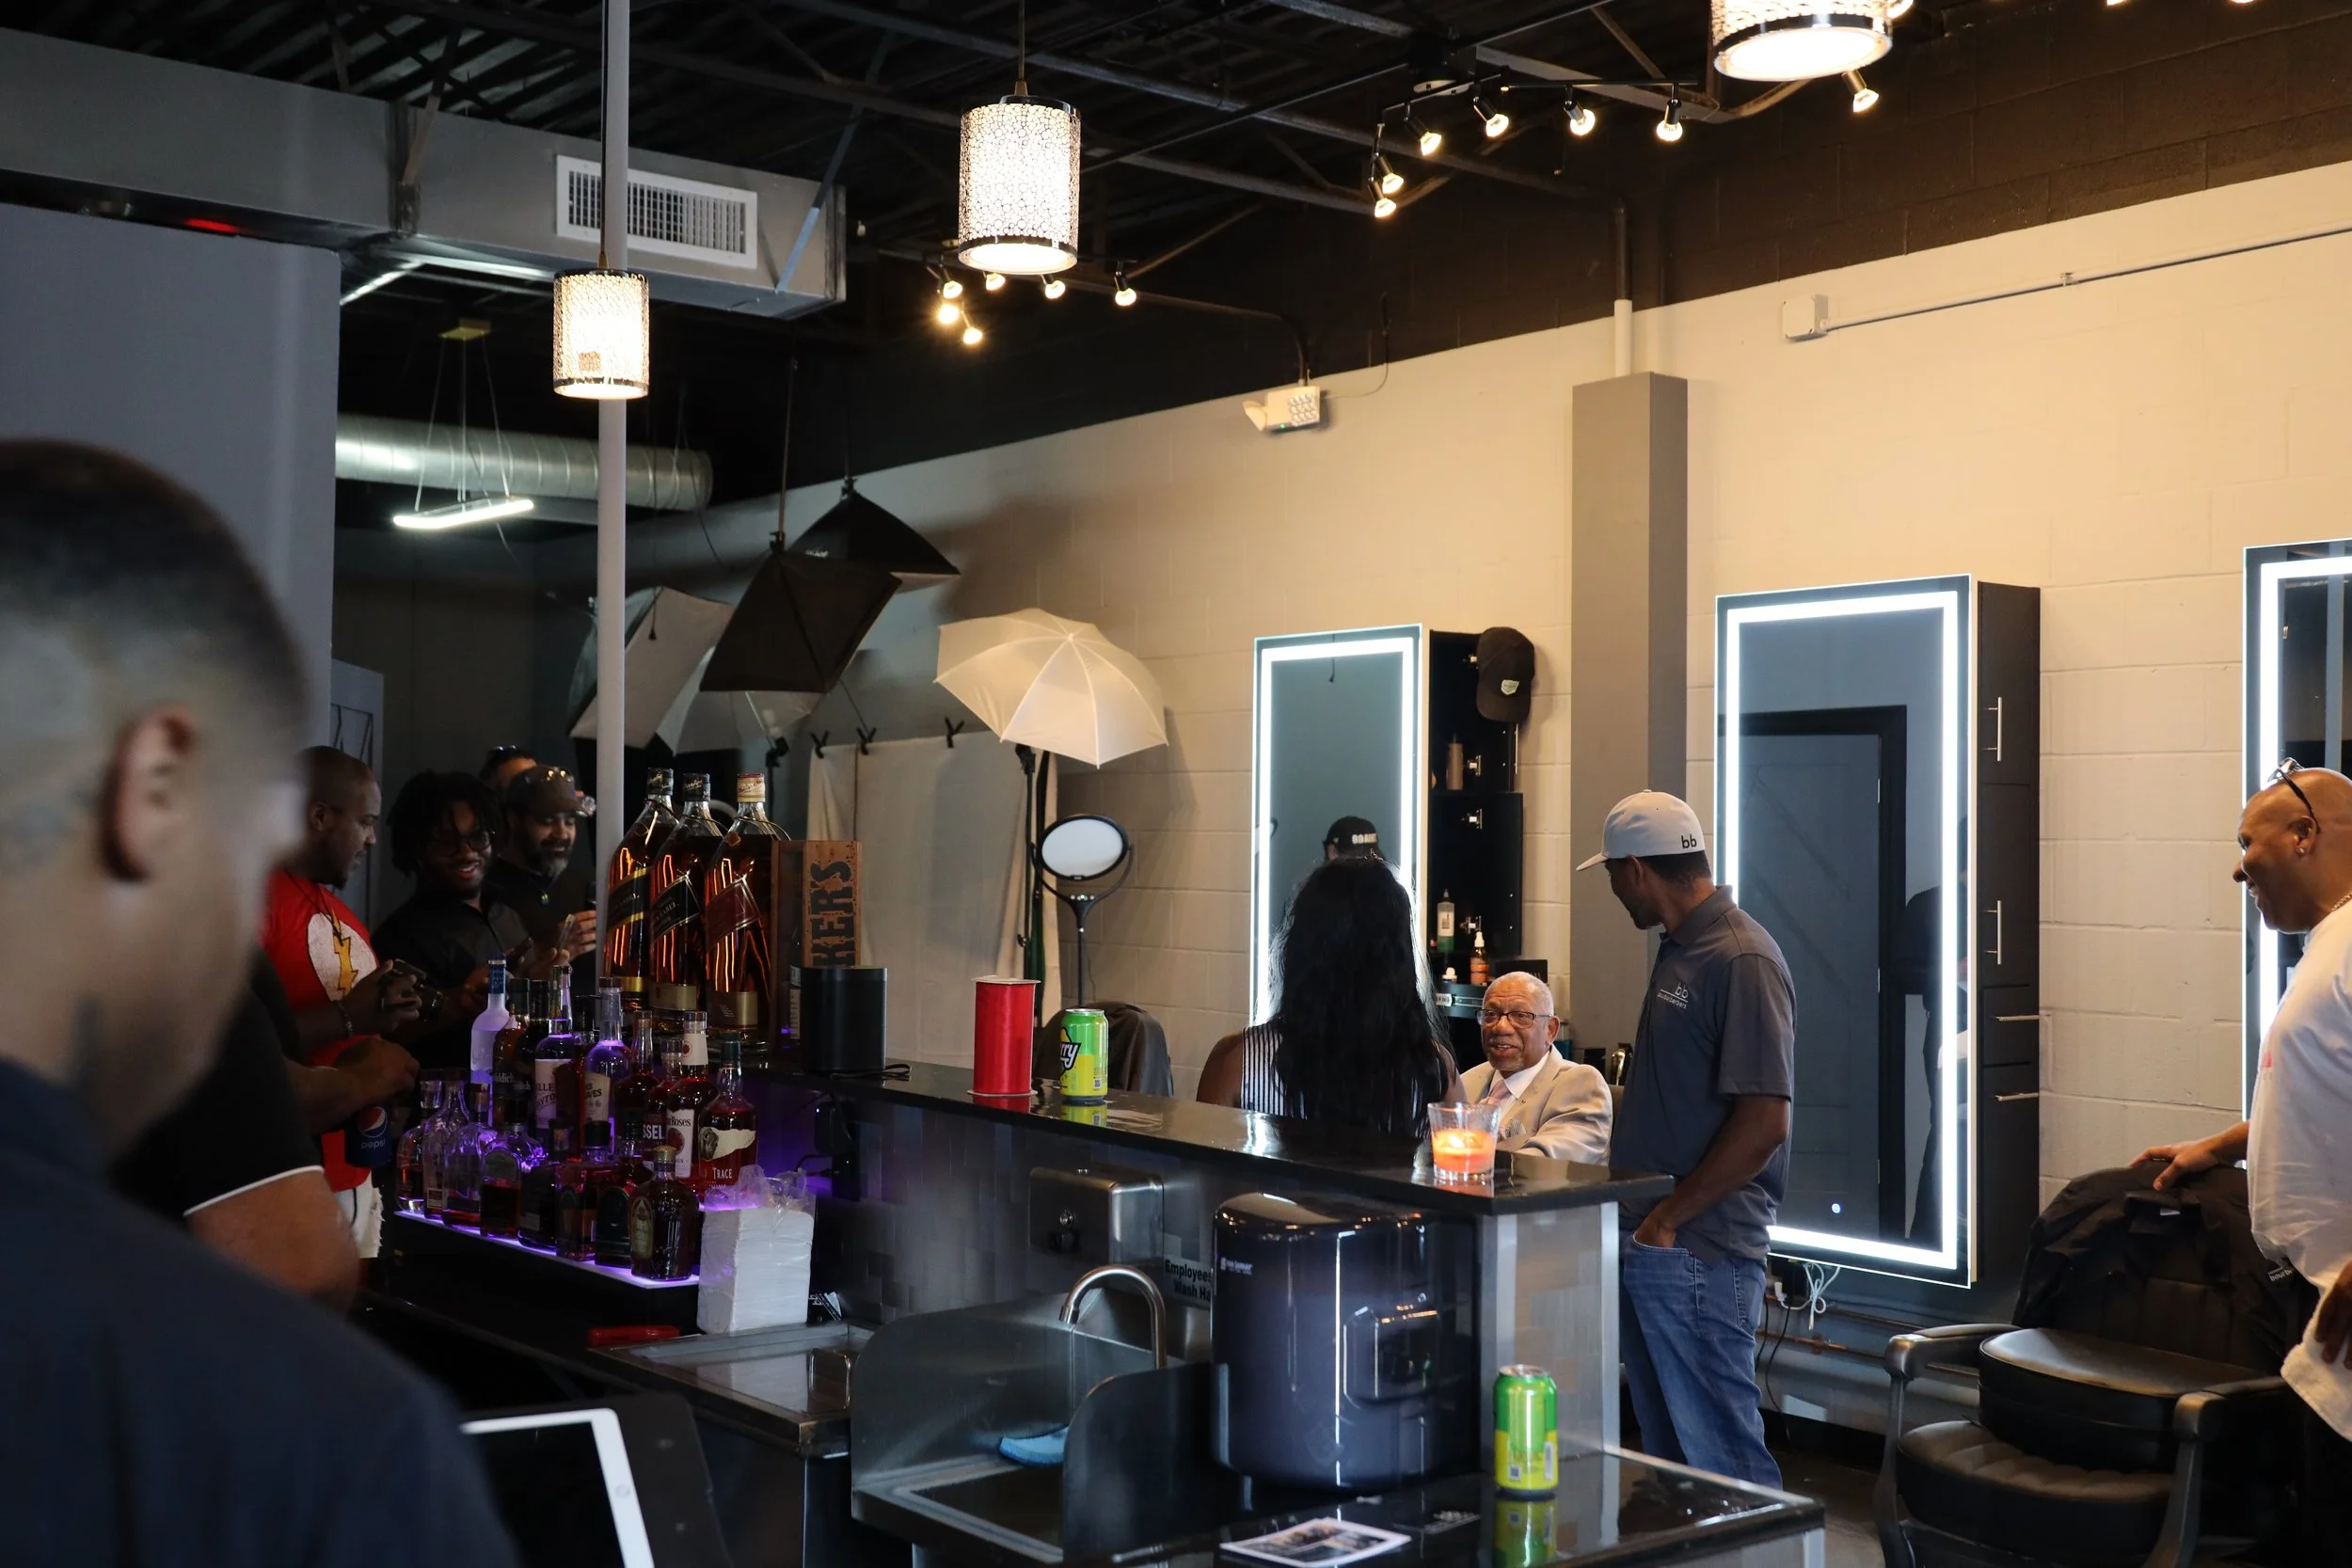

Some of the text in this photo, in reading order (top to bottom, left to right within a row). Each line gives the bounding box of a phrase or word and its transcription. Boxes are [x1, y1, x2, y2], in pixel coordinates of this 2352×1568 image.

[1680, 833, 1697, 849] bb
[1675, 981, 1689, 999] bb
[361, 1137, 386, 1150] pepsi
[1173, 1279, 1198, 1299] Wash
